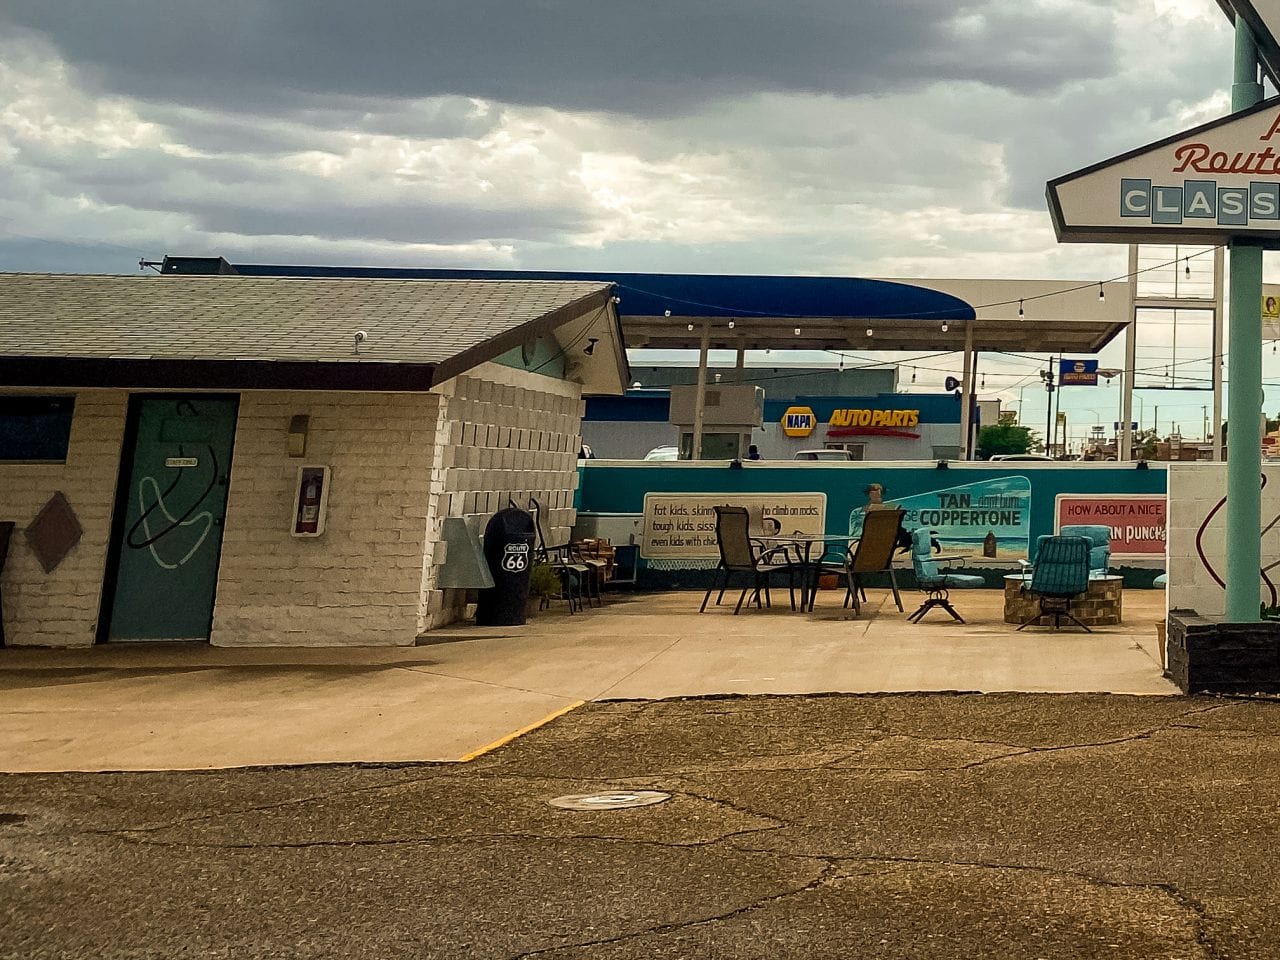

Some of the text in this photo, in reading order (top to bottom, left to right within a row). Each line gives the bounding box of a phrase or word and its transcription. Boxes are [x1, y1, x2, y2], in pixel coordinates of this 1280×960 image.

[787, 414, 811, 428] NAPA
[828, 410, 919, 427] AUTO PARTS
[937, 493, 971, 509] TAN
[654, 504, 667, 515] fat
[1068, 504, 1162, 515] HOW ABOUT A NICE
[903, 510, 1021, 526] se COPPERTONE
[652, 520, 674, 533] tough
[651, 538, 668, 546] even
[669, 535, 684, 546] kids
[685, 535, 702, 546] with
[506, 556, 524, 568] 66
